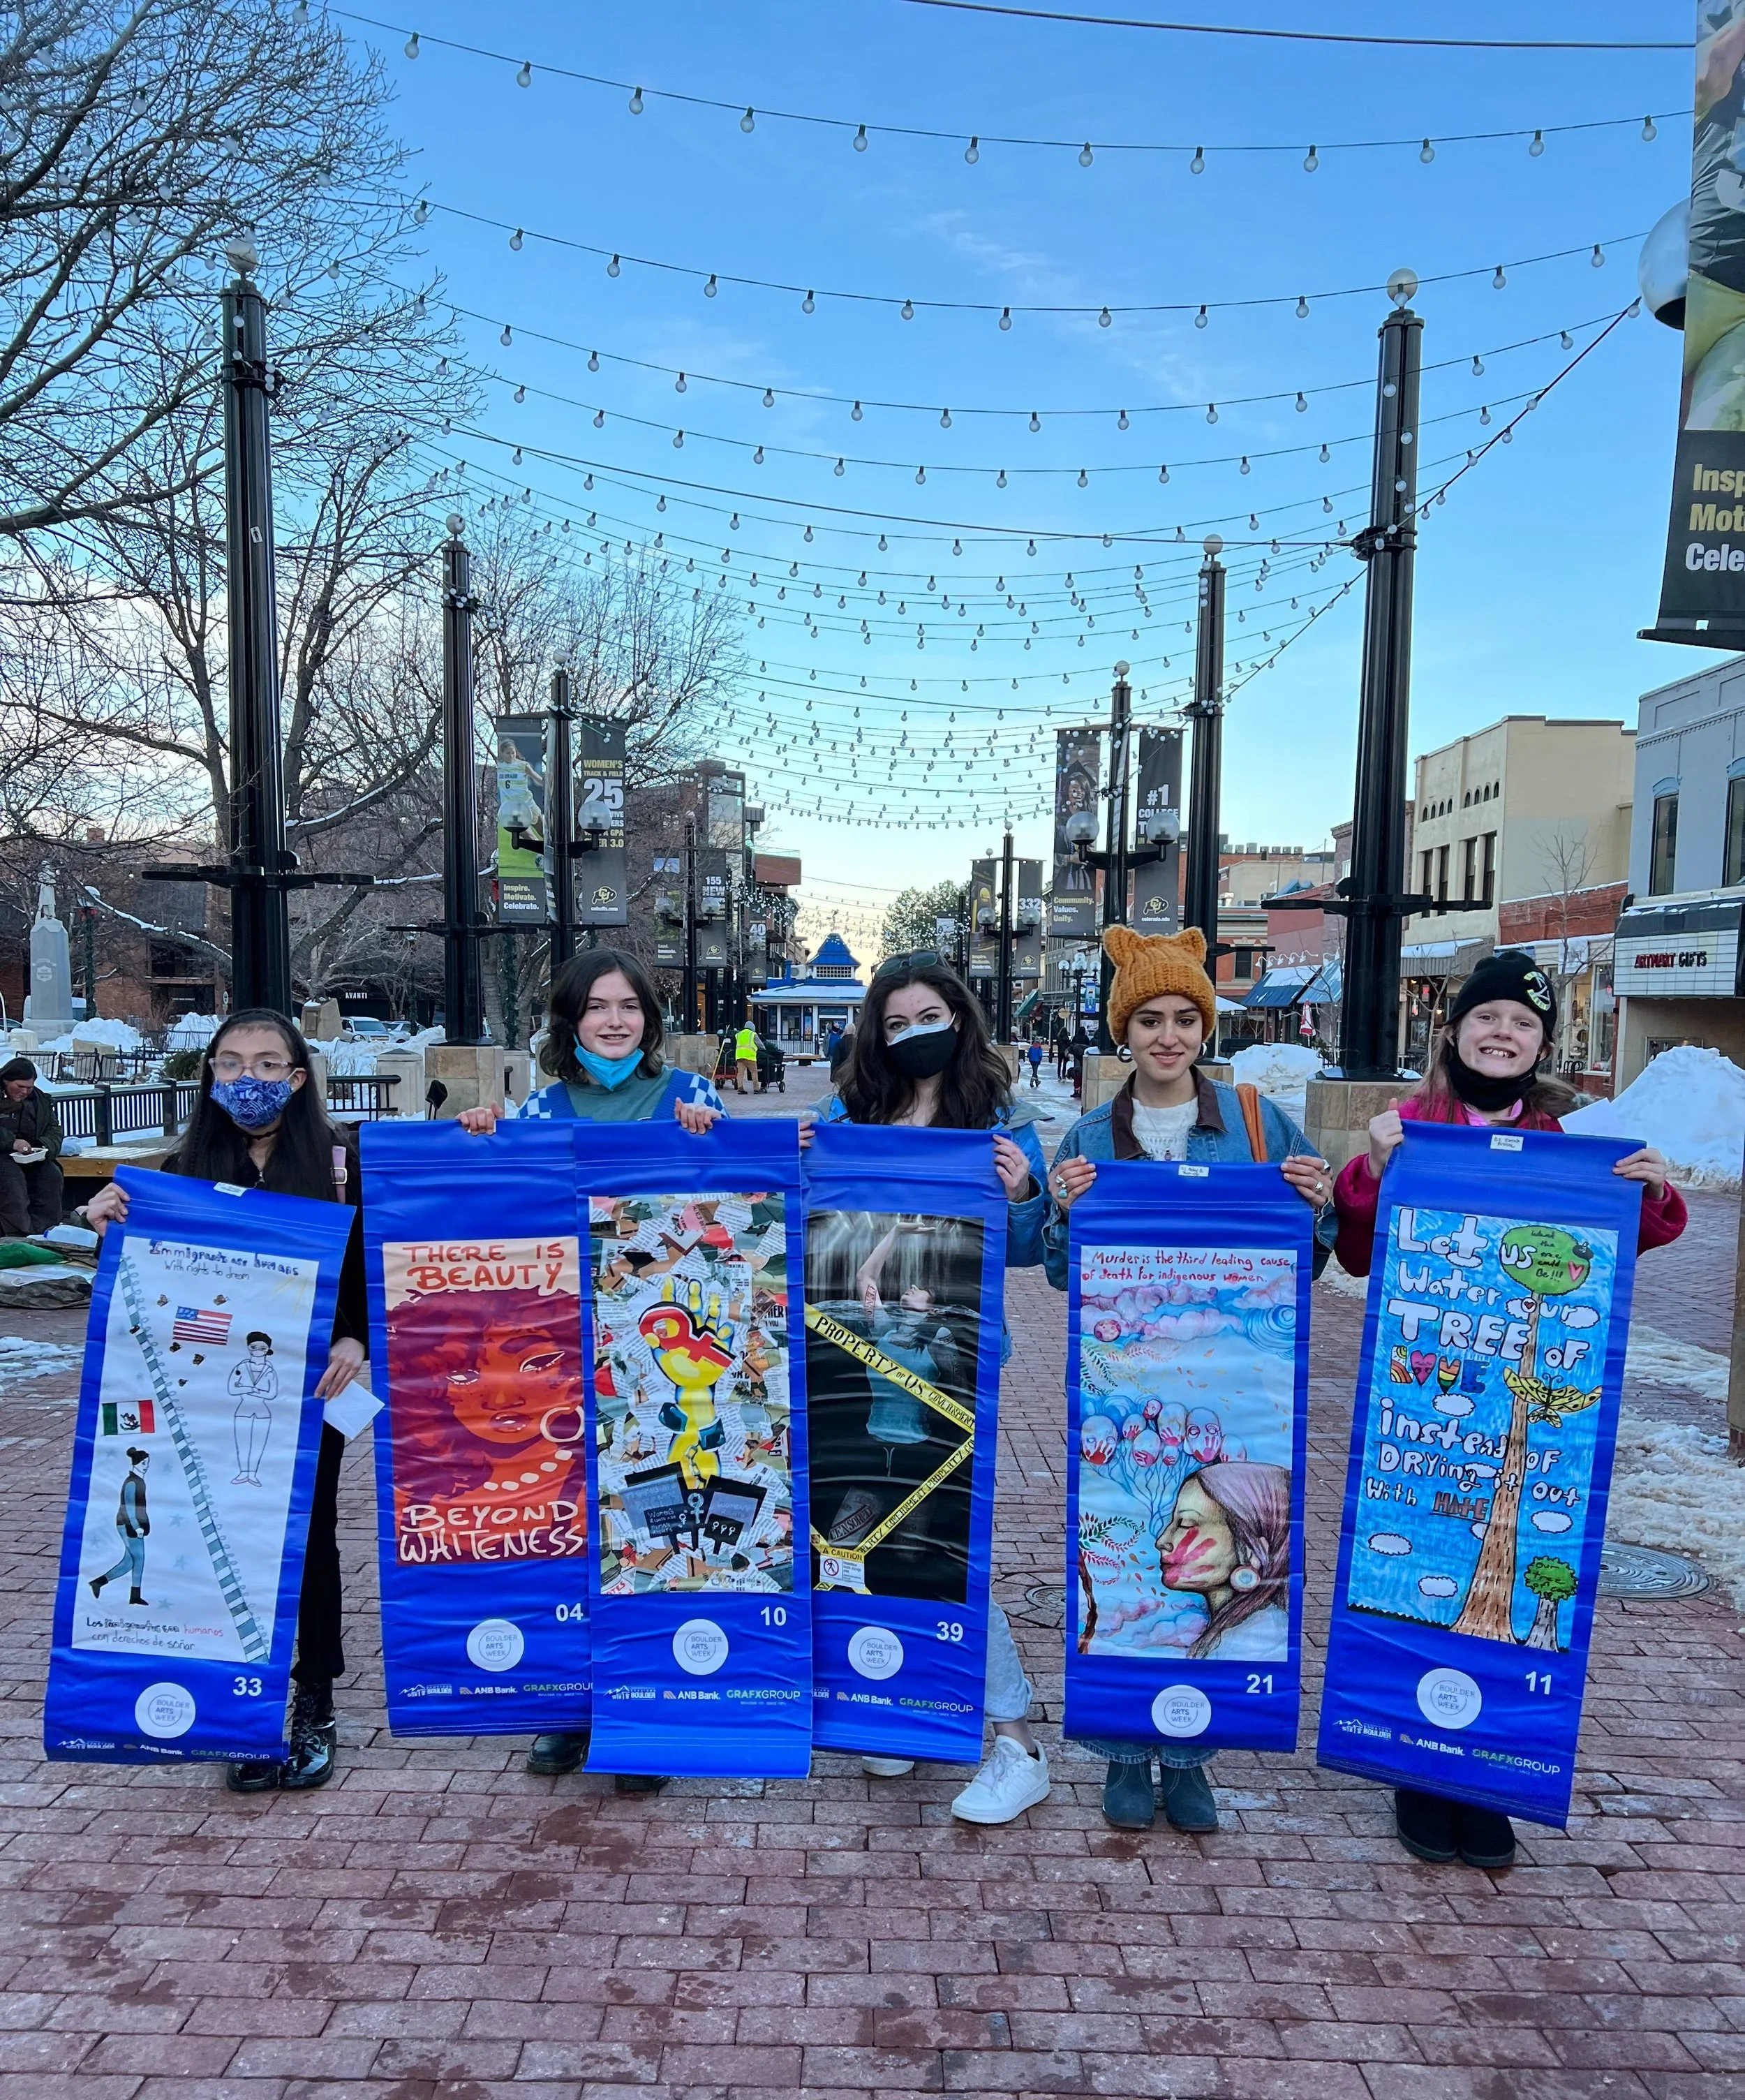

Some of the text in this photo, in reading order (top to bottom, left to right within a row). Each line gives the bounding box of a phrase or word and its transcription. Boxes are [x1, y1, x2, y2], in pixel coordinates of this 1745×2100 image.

[1689, 503, 1745, 531] Mot
[1685, 542, 1745, 572] Cele
[584, 759, 623, 769] WOMEN'S
[505, 780, 511, 789] 6
[584, 778, 624, 809] 25
[1147, 784, 1169, 806] #1
[1138, 808, 1179, 818] COLE
[610, 829, 624, 837] GPA
[609, 838, 624, 848] 3.0
[705, 875, 722, 885] 155
[503, 884, 530, 892] Inspire.
[503, 893, 536, 901] Motivate.
[1018, 898, 1041, 910] 332
[1053, 896, 1094, 905] Community.
[503, 901, 539, 910] Celebrate.
[1053, 915, 1074, 924] Unity.
[750, 924, 766, 936] 40
[1634, 950, 1708, 969] ARTMART GIFTS
[1397, 1208, 1489, 1259] Let
[149, 1239, 228, 1264] Immigrants
[254, 1252, 300, 1276] humans
[402, 1243, 565, 1263] THERE IS
[1092, 1250, 1291, 1271] Murder is the third leading cause
[186, 1261, 209, 1276] rights
[212, 1264, 223, 1276] to
[225, 1266, 250, 1280] dream
[406, 1262, 563, 1290] BEAUTY
[1082, 1269, 1094, 1281] of
[1099, 1266, 1133, 1280] death
[1138, 1266, 1154, 1280] for
[1158, 1268, 1216, 1287] indigenous
[1399, 1261, 1502, 1306] Water
[1387, 1299, 1532, 1361] TREE
[814, 1315, 900, 1375] PROPERTY
[928, 1391, 975, 1426] GOVERNMENT
[927, 1451, 965, 1491] PROPERTY
[400, 1500, 579, 1532] BEYOND
[829, 1506, 873, 1540] CENSORED
[399, 1524, 584, 1562] WHITENESS
[831, 1550, 863, 1561] CAUTION
[556, 1603, 584, 1622] 04
[760, 1606, 787, 1627] 10
[87, 1617, 103, 1627] Los
[184, 1624, 223, 1637] humanos
[936, 1621, 964, 1642] 39
[91, 1629, 195, 1651] con derechos de soñar
[485, 1634, 518, 1642] BOULDER
[866, 1642, 898, 1652] BOULDER
[232, 1676, 262, 1696] 33
[523, 1683, 593, 1692] GRAFXGROU
[1246, 1673, 1272, 1694] 21
[1526, 1671, 1552, 1695] 11
[474, 1686, 493, 1695] ANB
[677, 1691, 697, 1699] ANB
[726, 1689, 801, 1700] GRAFXGROUP
[812, 1690, 829, 1699] ULDER
[1439, 1684, 1476, 1698] BOULDER
[156, 1699, 190, 1709] BOULDER
[851, 1693, 870, 1703] ANB
[899, 1697, 974, 1713] GRAFXGROUP
[1438, 1693, 1457, 1703] ARTS
[1438, 1700, 1460, 1711] WEEK
[1363, 1728, 1392, 1739] BOULDER
[140, 1744, 160, 1753] ANB
[1416, 1738, 1439, 1751] ANB
[191, 1749, 270, 1760] GRAFXGROUP
[1472, 1748, 1560, 1775] GRAFXGROUP
